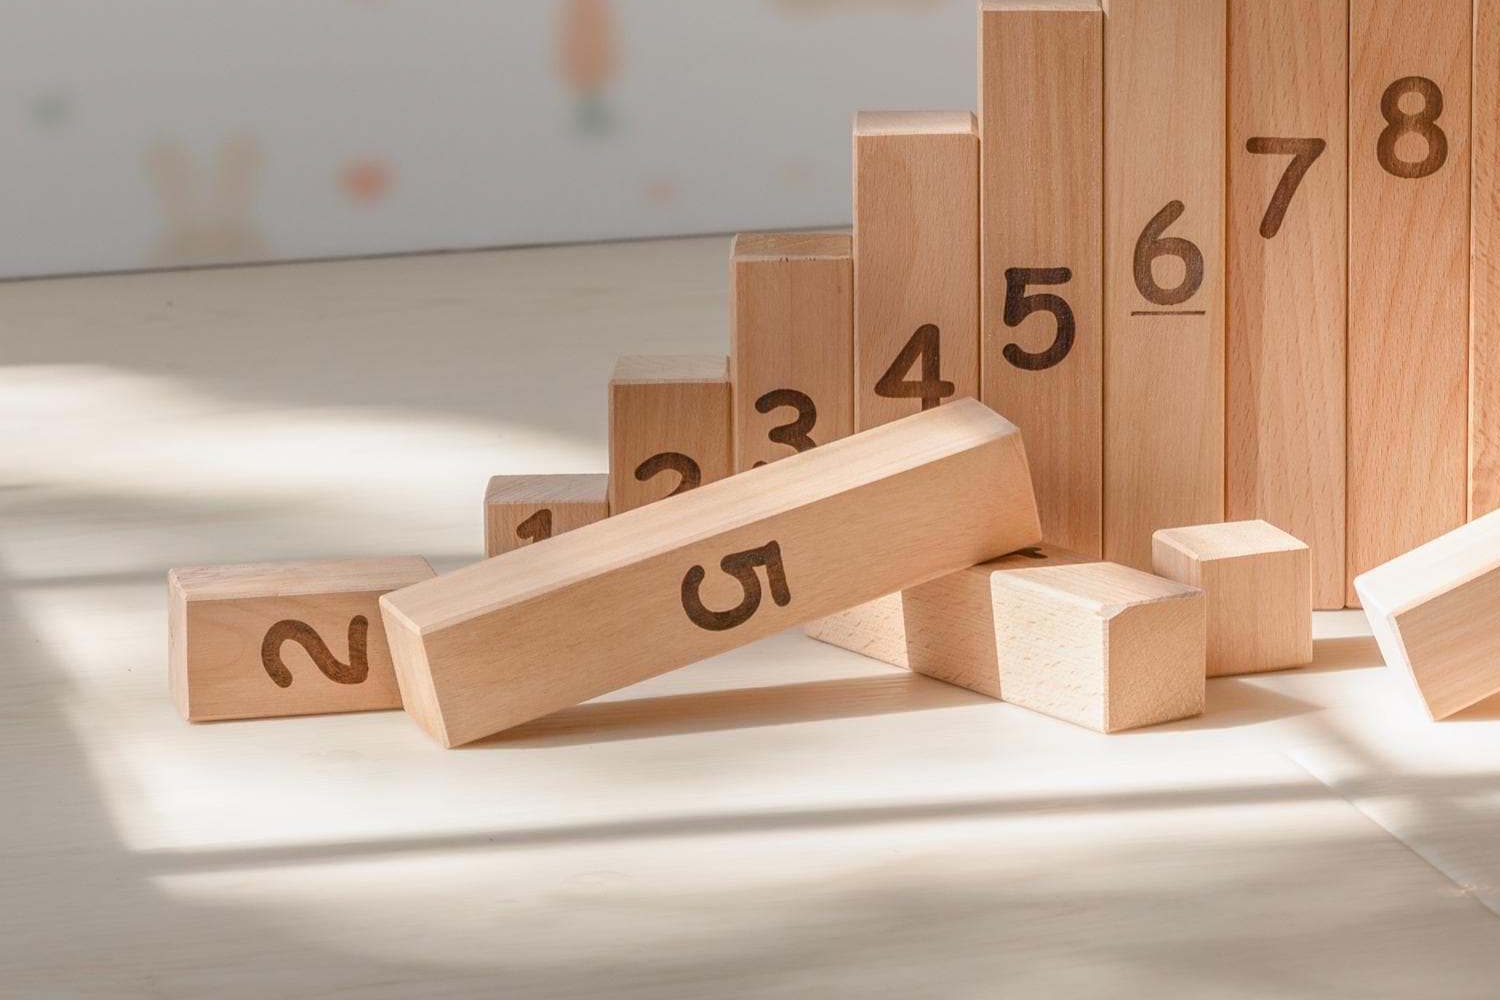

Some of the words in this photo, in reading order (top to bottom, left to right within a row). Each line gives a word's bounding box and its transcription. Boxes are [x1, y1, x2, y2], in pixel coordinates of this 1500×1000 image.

[1376, 76, 1449, 179] 8
[1246, 137, 1326, 239] 7
[1132, 200, 1205, 306] 6
[874, 323, 955, 411] 4
[1002, 267, 1076, 371] 5
[754, 389, 818, 467] 3
[681, 539, 792, 632] 5
[261, 614, 369, 689] 2
